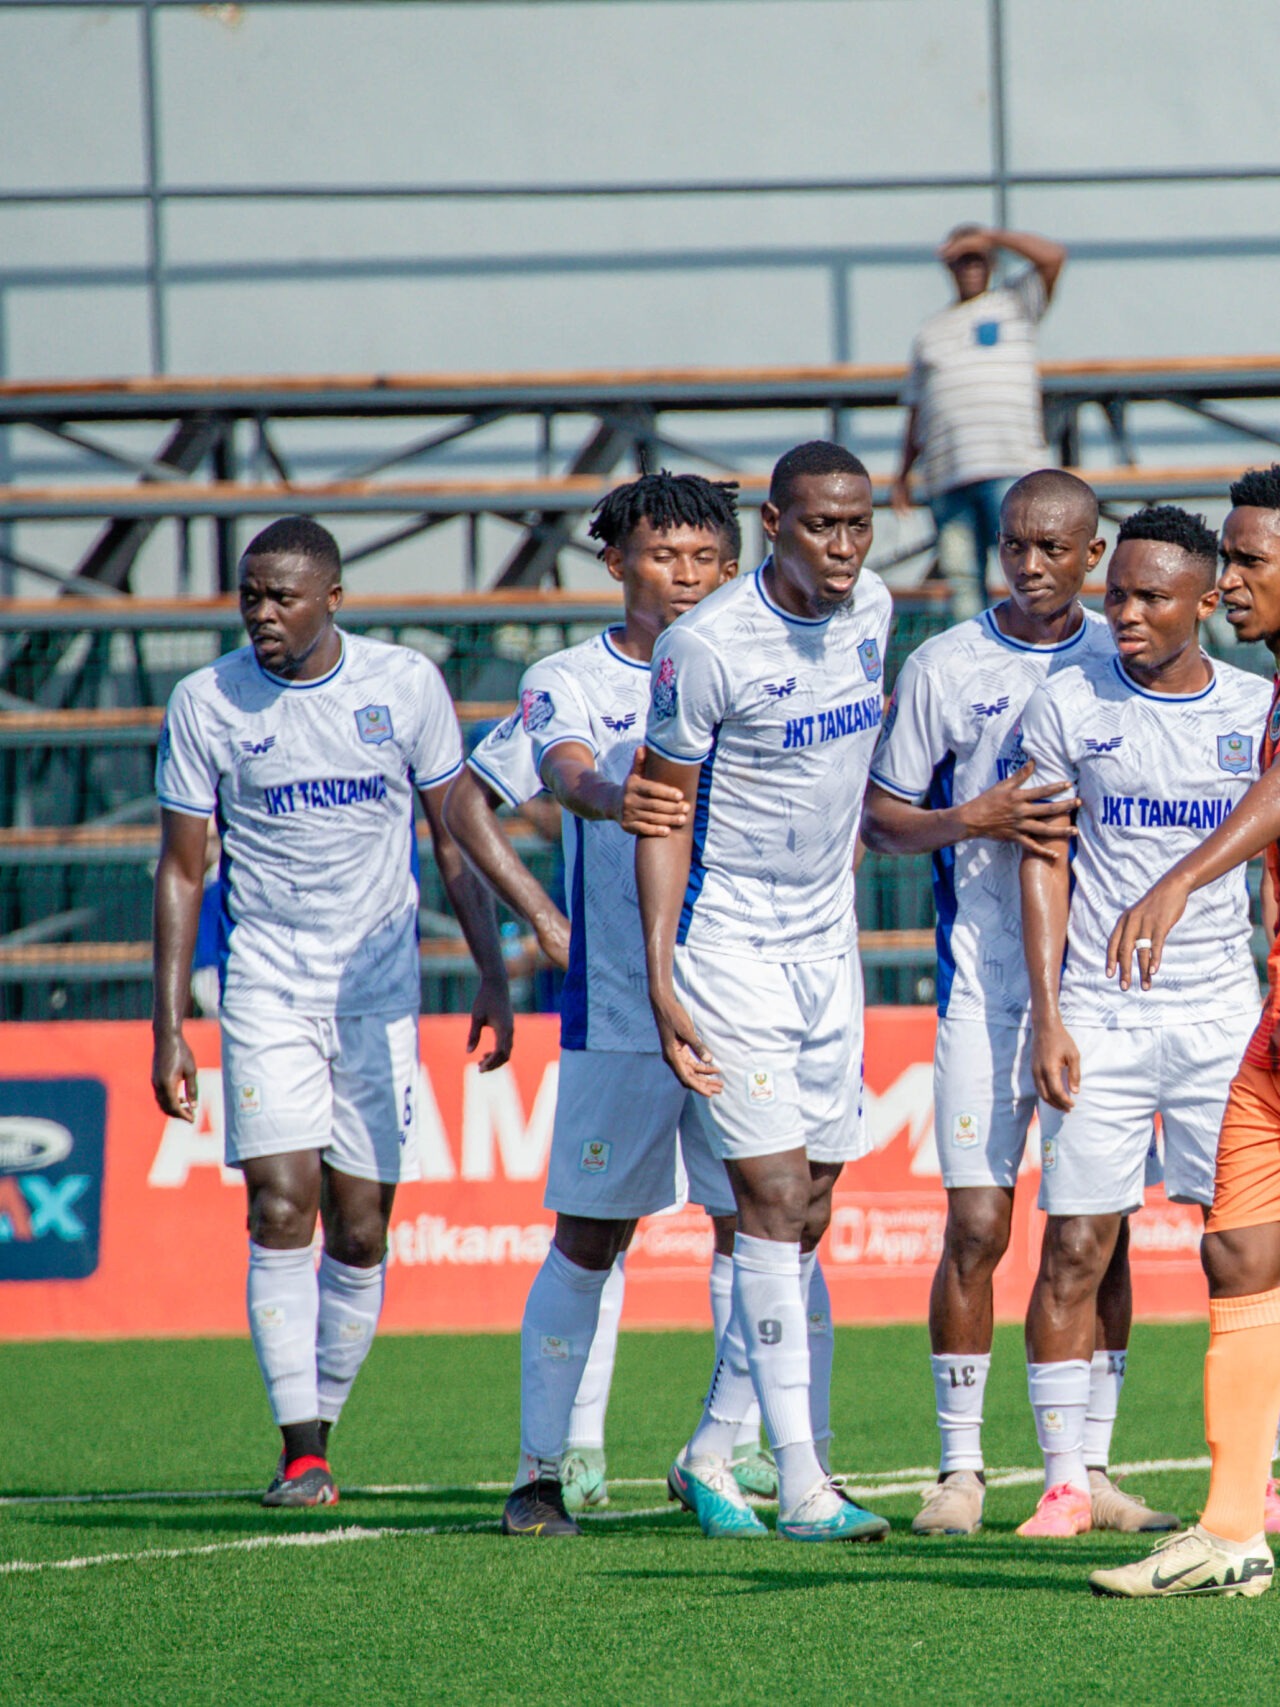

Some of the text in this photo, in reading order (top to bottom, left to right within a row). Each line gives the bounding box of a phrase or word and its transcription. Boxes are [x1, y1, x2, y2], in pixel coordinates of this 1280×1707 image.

[782, 694, 882, 748] JKT TANZANIA
[264, 773, 387, 815] JKT TANZANIA
[1101, 796, 1134, 826] JKT
[388, 1212, 551, 1266] tikana
[758, 1318, 782, 1345] 9
